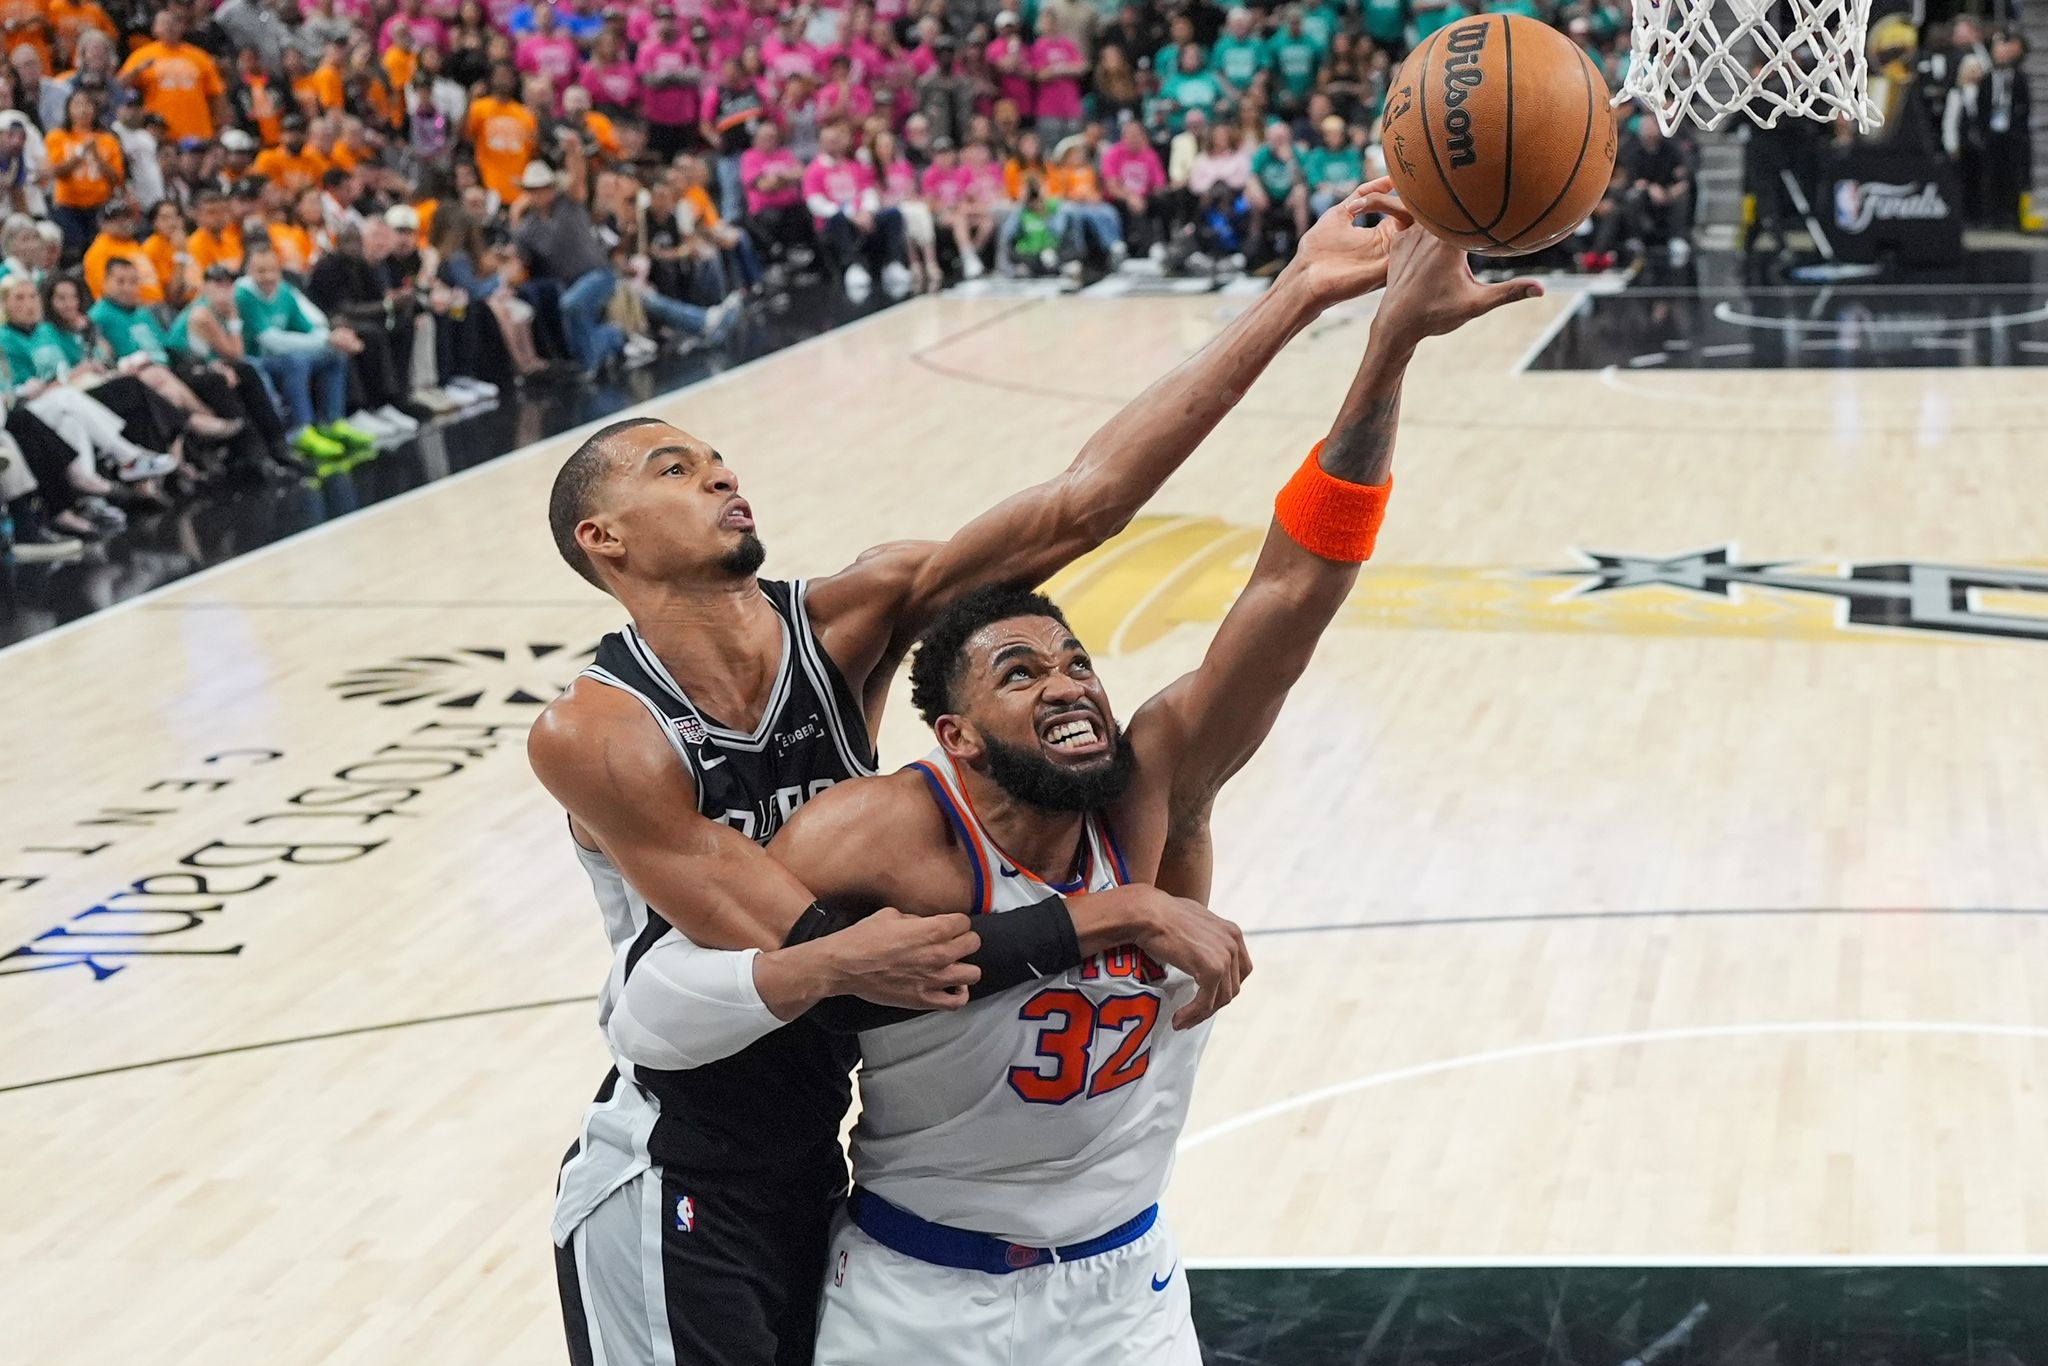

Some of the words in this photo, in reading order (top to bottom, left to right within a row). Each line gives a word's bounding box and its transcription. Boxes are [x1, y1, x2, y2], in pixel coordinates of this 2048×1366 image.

[1444, 21, 1490, 171] Wilson
[1851, 181, 1949, 234] Finals
[246, 722, 534, 825] Frost
[0, 837, 390, 980] Bank
[1007, 988, 1161, 1105] 32
